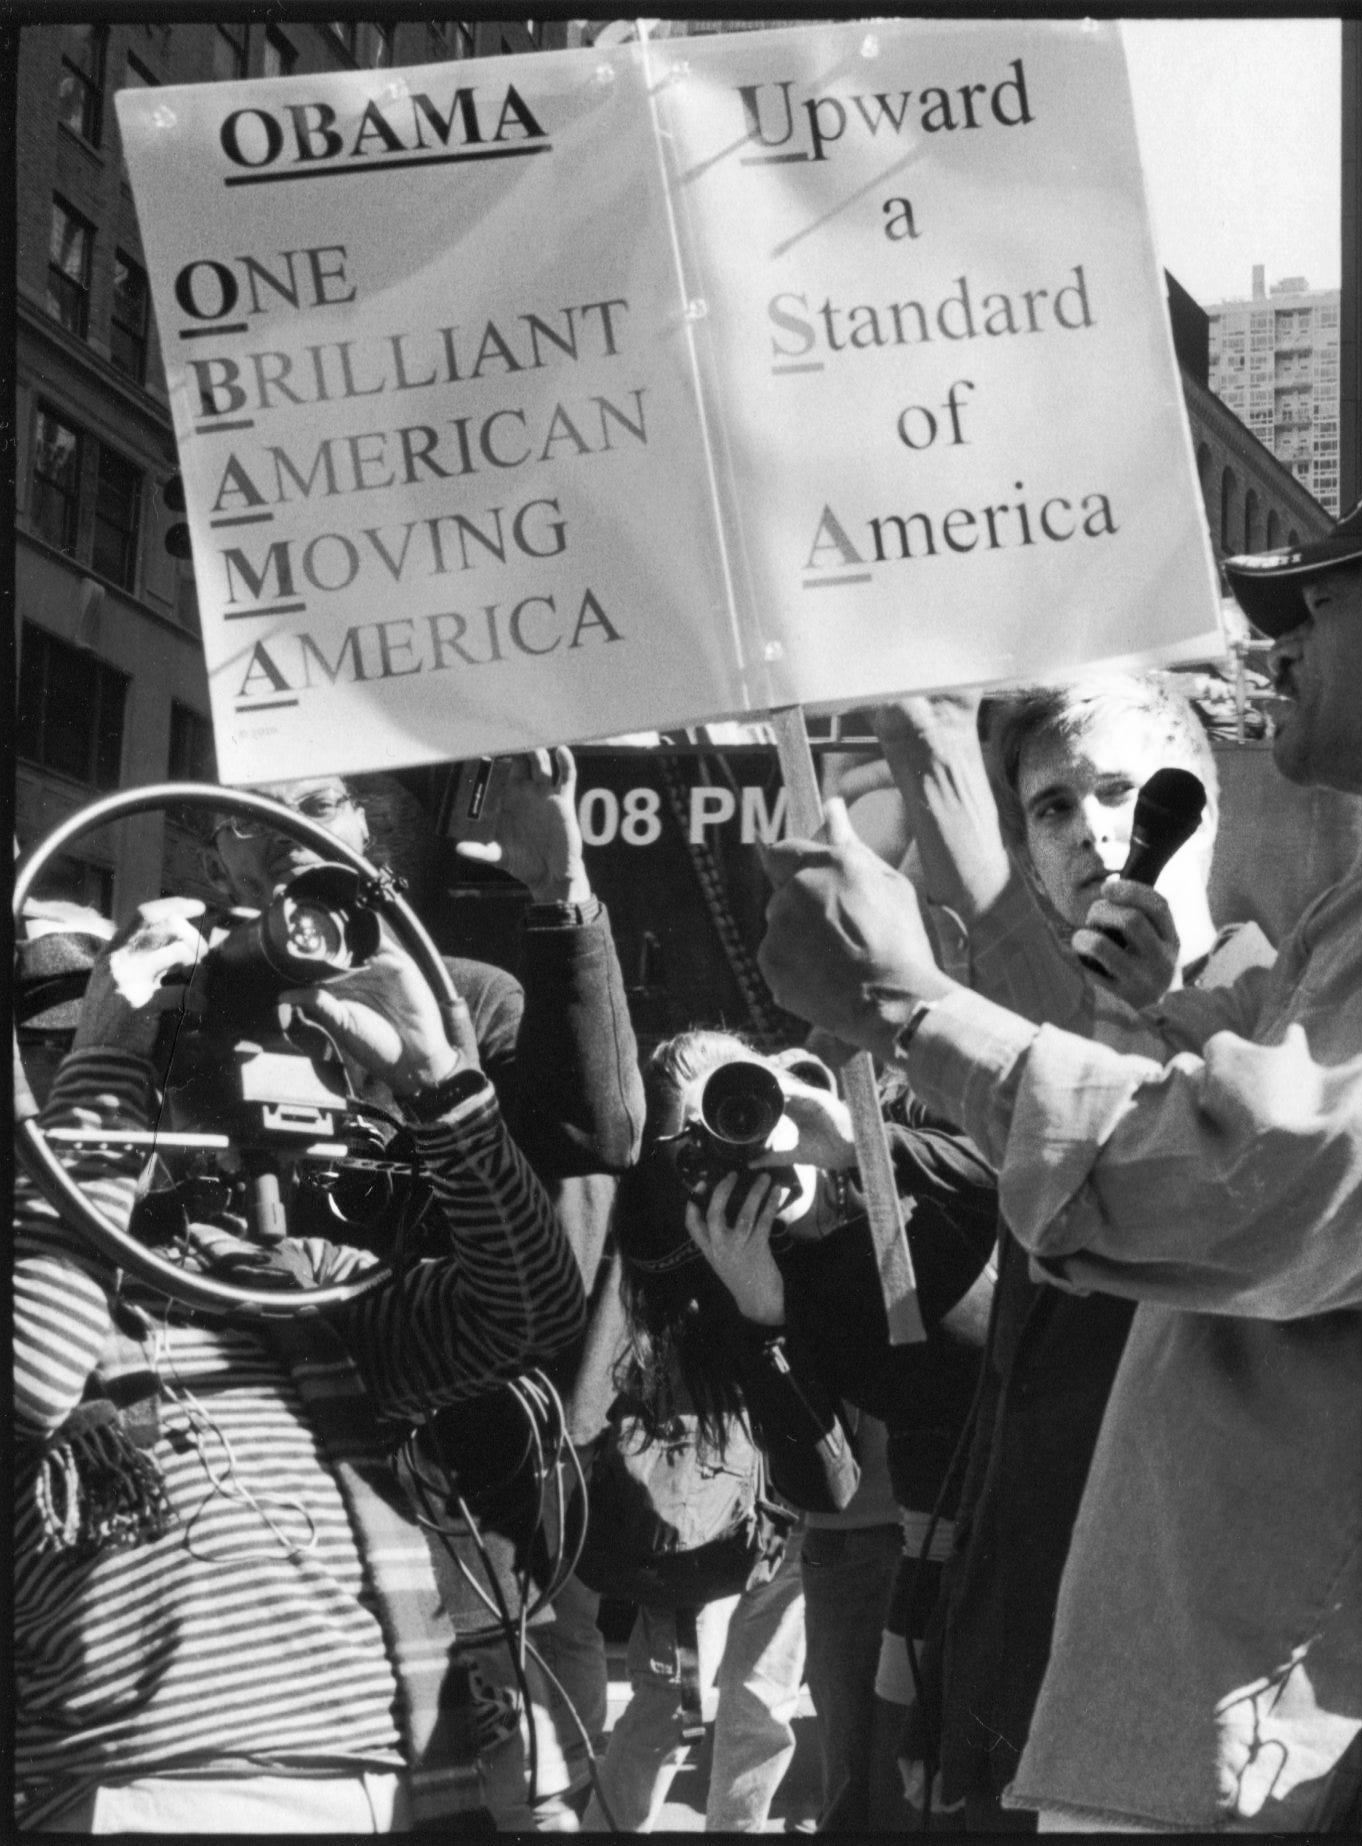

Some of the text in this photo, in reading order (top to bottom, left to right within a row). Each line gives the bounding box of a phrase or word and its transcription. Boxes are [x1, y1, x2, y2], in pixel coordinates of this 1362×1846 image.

[219, 83, 549, 169] OBAMA
[738, 58, 1035, 161] Upward
[882, 196, 922, 242] a
[174, 245, 358, 321] ONE
[767, 264, 1098, 358] Standard
[190, 299, 630, 418] BRILLIANT
[211, 387, 650, 513] AMERICAN
[896, 379, 976, 450] of
[219, 497, 569, 605] MOVING
[802, 480, 1122, 569] America
[234, 587, 626, 698] AMERICA
[689, 786, 791, 845] PM
